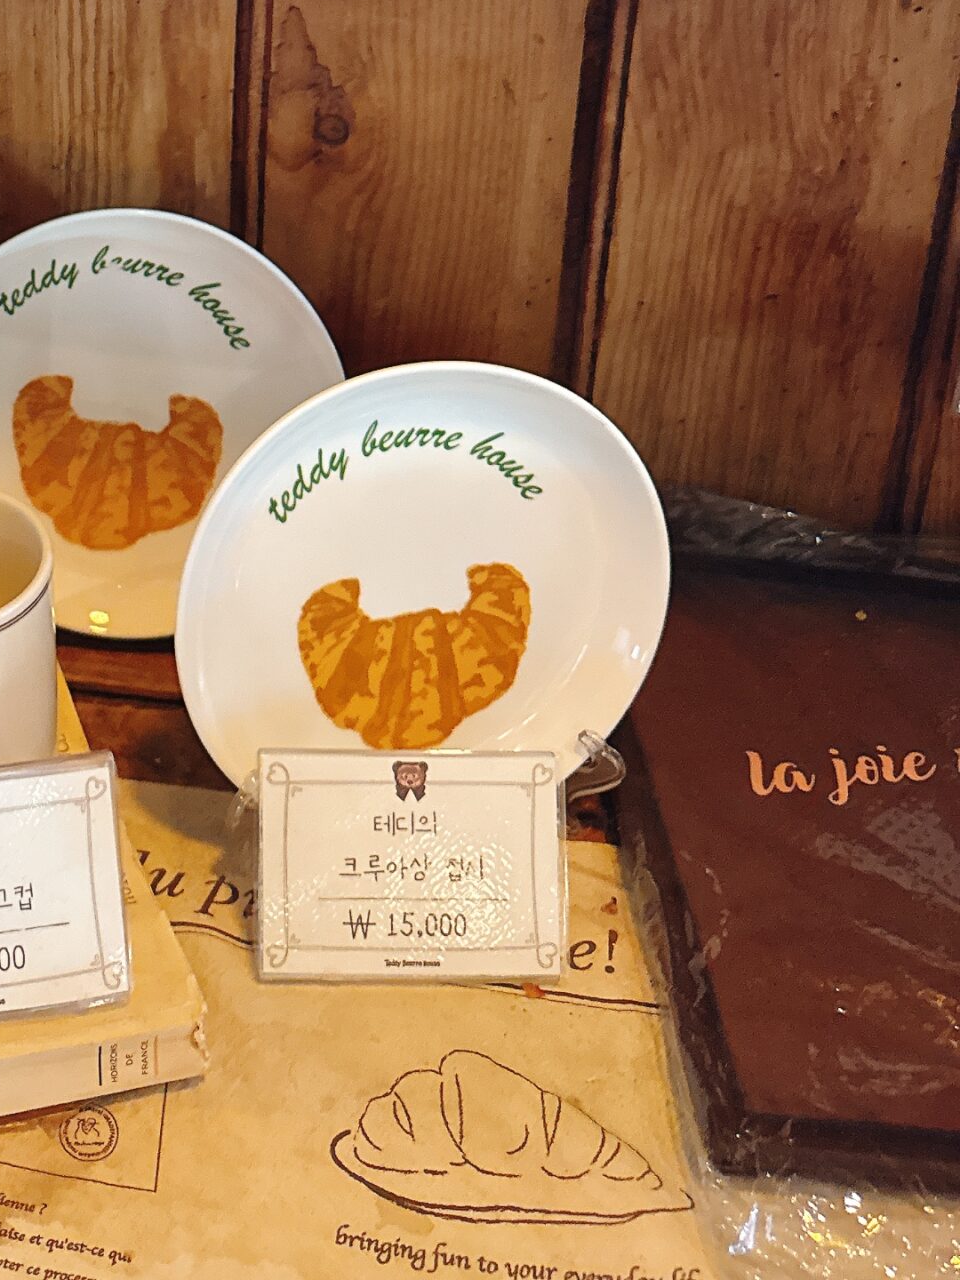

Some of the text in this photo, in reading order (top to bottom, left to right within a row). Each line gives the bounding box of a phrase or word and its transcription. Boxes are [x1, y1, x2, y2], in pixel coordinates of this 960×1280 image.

[0, 259, 79, 315] teddy
[188, 282, 251, 350] house
[268, 420, 543, 523] teddy beurre house
[745, 750, 816, 796] la
[828, 745, 937, 806] joie
[373, 811, 438, 837] 테디의
[339, 854, 431, 883] 크루아상
[388, 912, 467, 939] 15,000
[109, 1043, 118, 1083] HORIZONS
[125, 1053, 134, 1066] DE
[140, 1040, 149, 1075] FRANCE
[29, 1234, 43, 1246] et
[46, 1237, 105, 1258] qu'est-ce
[335, 1224, 426, 1271] bringing
[428, 1242, 471, 1273] fun
[477, 1255, 499, 1274] to
[504, 1262, 558, 1280] your
[26, 1265, 41, 1276] ce
